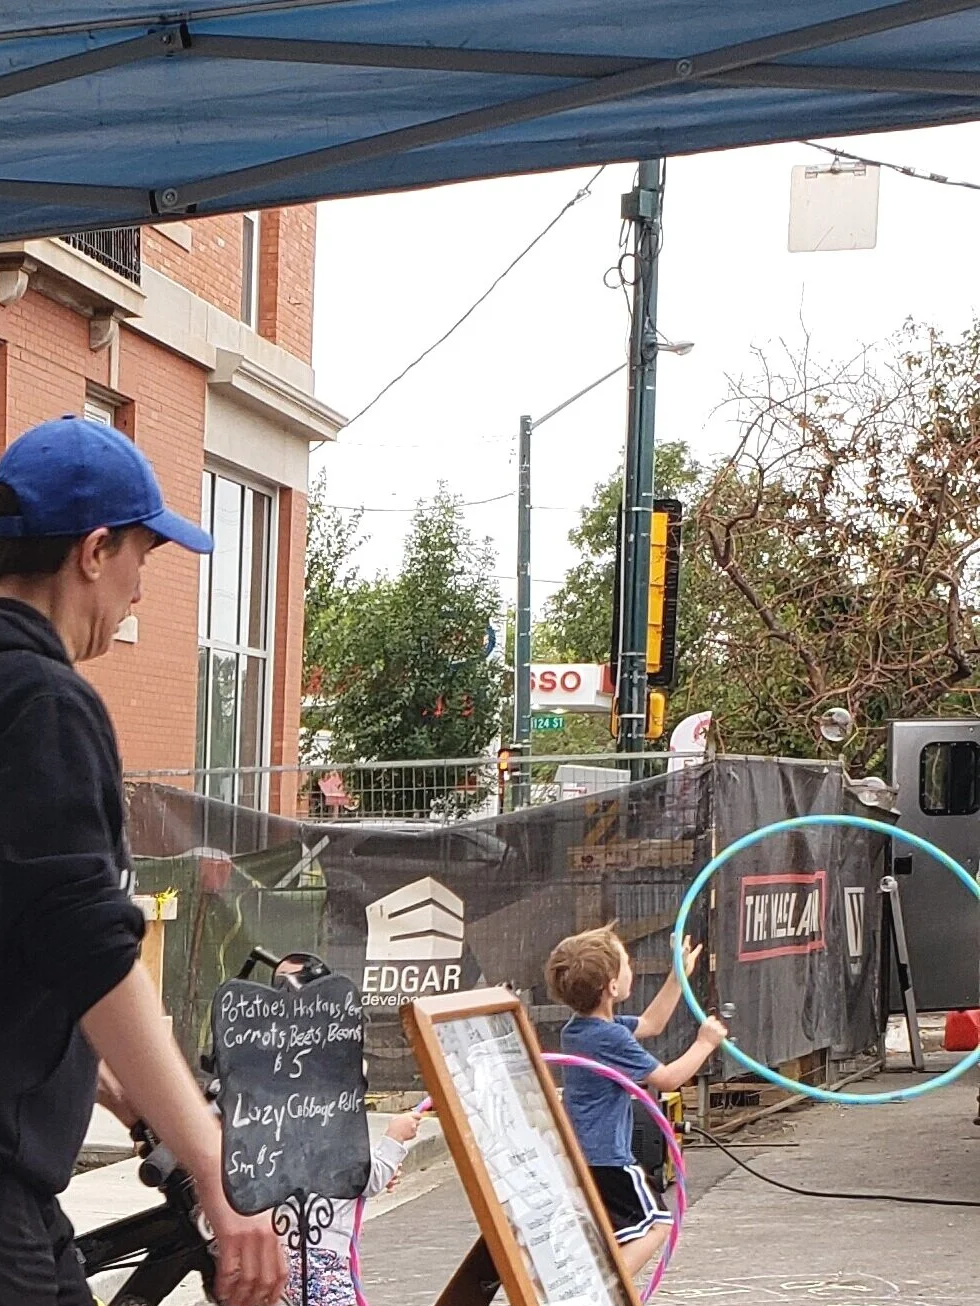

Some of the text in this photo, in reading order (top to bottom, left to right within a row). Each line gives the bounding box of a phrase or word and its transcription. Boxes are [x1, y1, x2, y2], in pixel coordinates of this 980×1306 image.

[552, 717, 563, 728] ST
[745, 894, 769, 942] THE
[362, 964, 461, 993] EDGAR
[221, 990, 289, 1022] Potatoes,
[232, 1093, 285, 1141] Lazy
[287, 1093, 336, 1126] Cabbage
[228, 1151, 255, 1179] Sm
